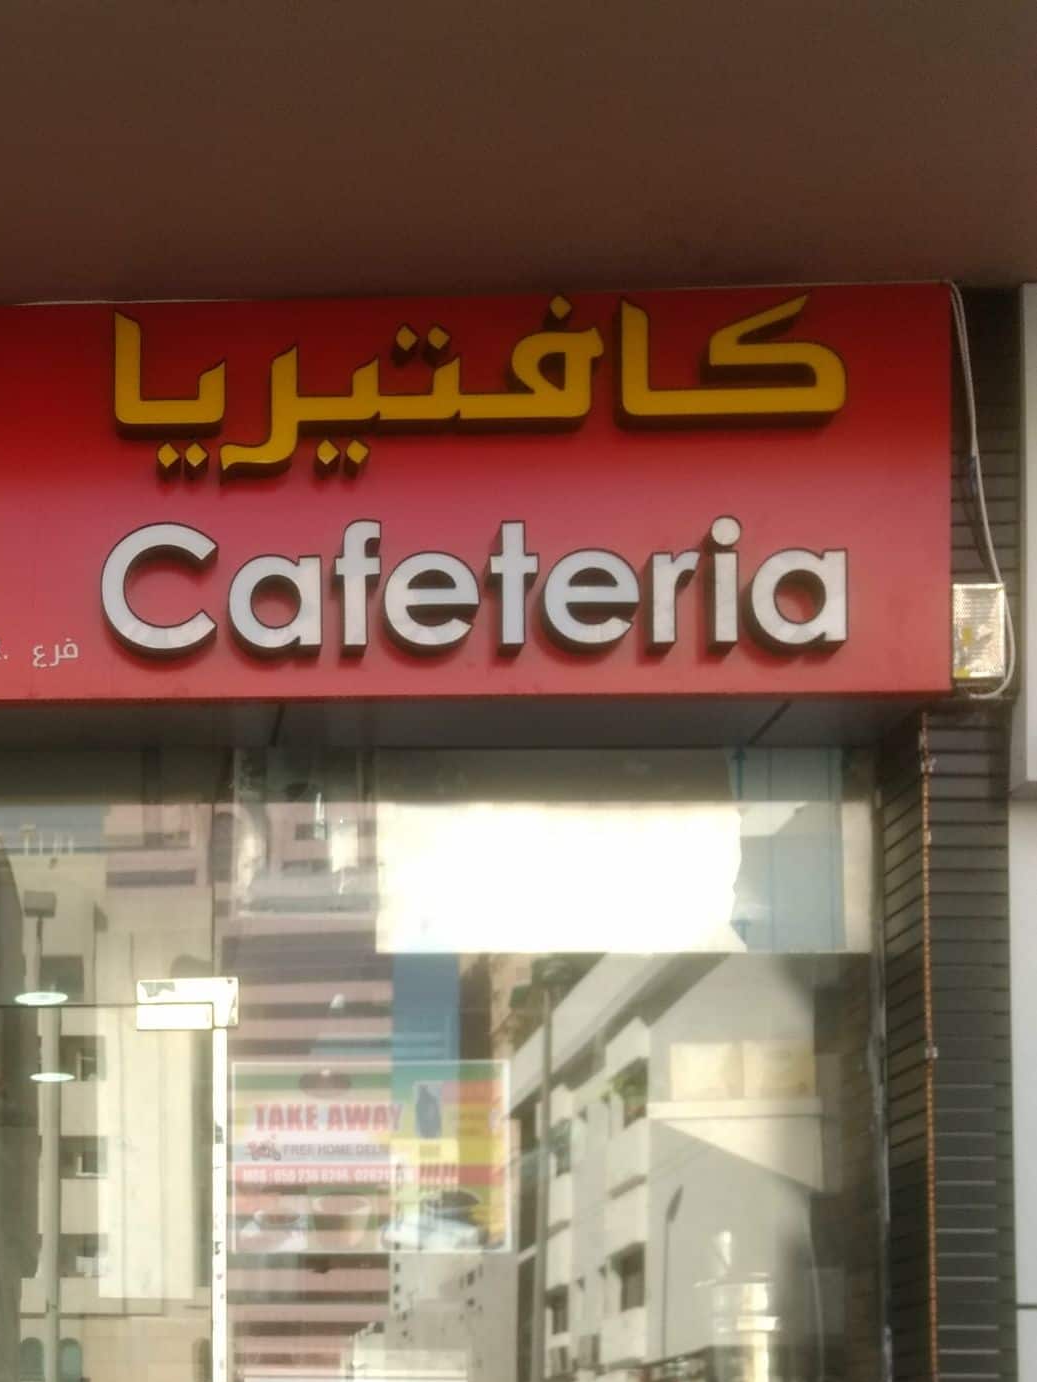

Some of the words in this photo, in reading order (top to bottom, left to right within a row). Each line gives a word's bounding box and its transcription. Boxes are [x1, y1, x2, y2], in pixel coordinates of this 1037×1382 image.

[113, 295, 848, 478] كافتيريا
[100, 514, 849, 656] Cafeteria
[32, 637, 79, 668] فرع
[254, 1103, 319, 1131] TAKE
[327, 1103, 404, 1131] AWAY
